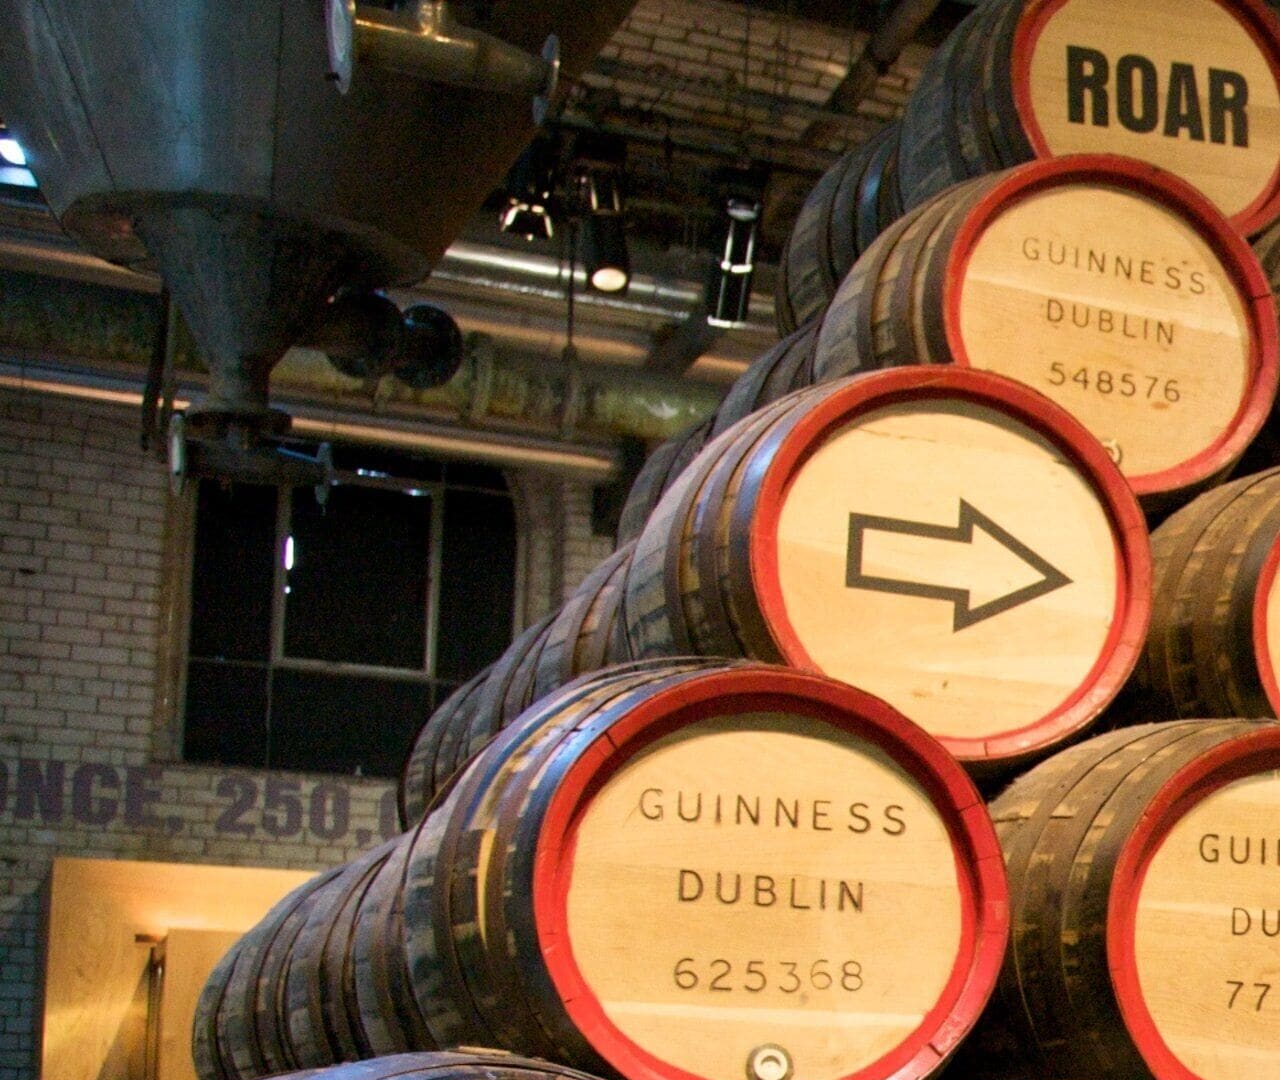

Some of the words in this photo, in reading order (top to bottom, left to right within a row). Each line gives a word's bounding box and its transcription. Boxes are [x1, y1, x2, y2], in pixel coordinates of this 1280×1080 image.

[1066, 45, 1249, 148] ROAR
[1022, 237, 1207, 296] GUINNESS
[1046, 299, 1175, 345] DUBLIN
[1050, 362, 1181, 403] 548576
[639, 788, 906, 836] GUINNESS
[678, 870, 863, 912] DUBLIN
[674, 957, 864, 992] 625368
